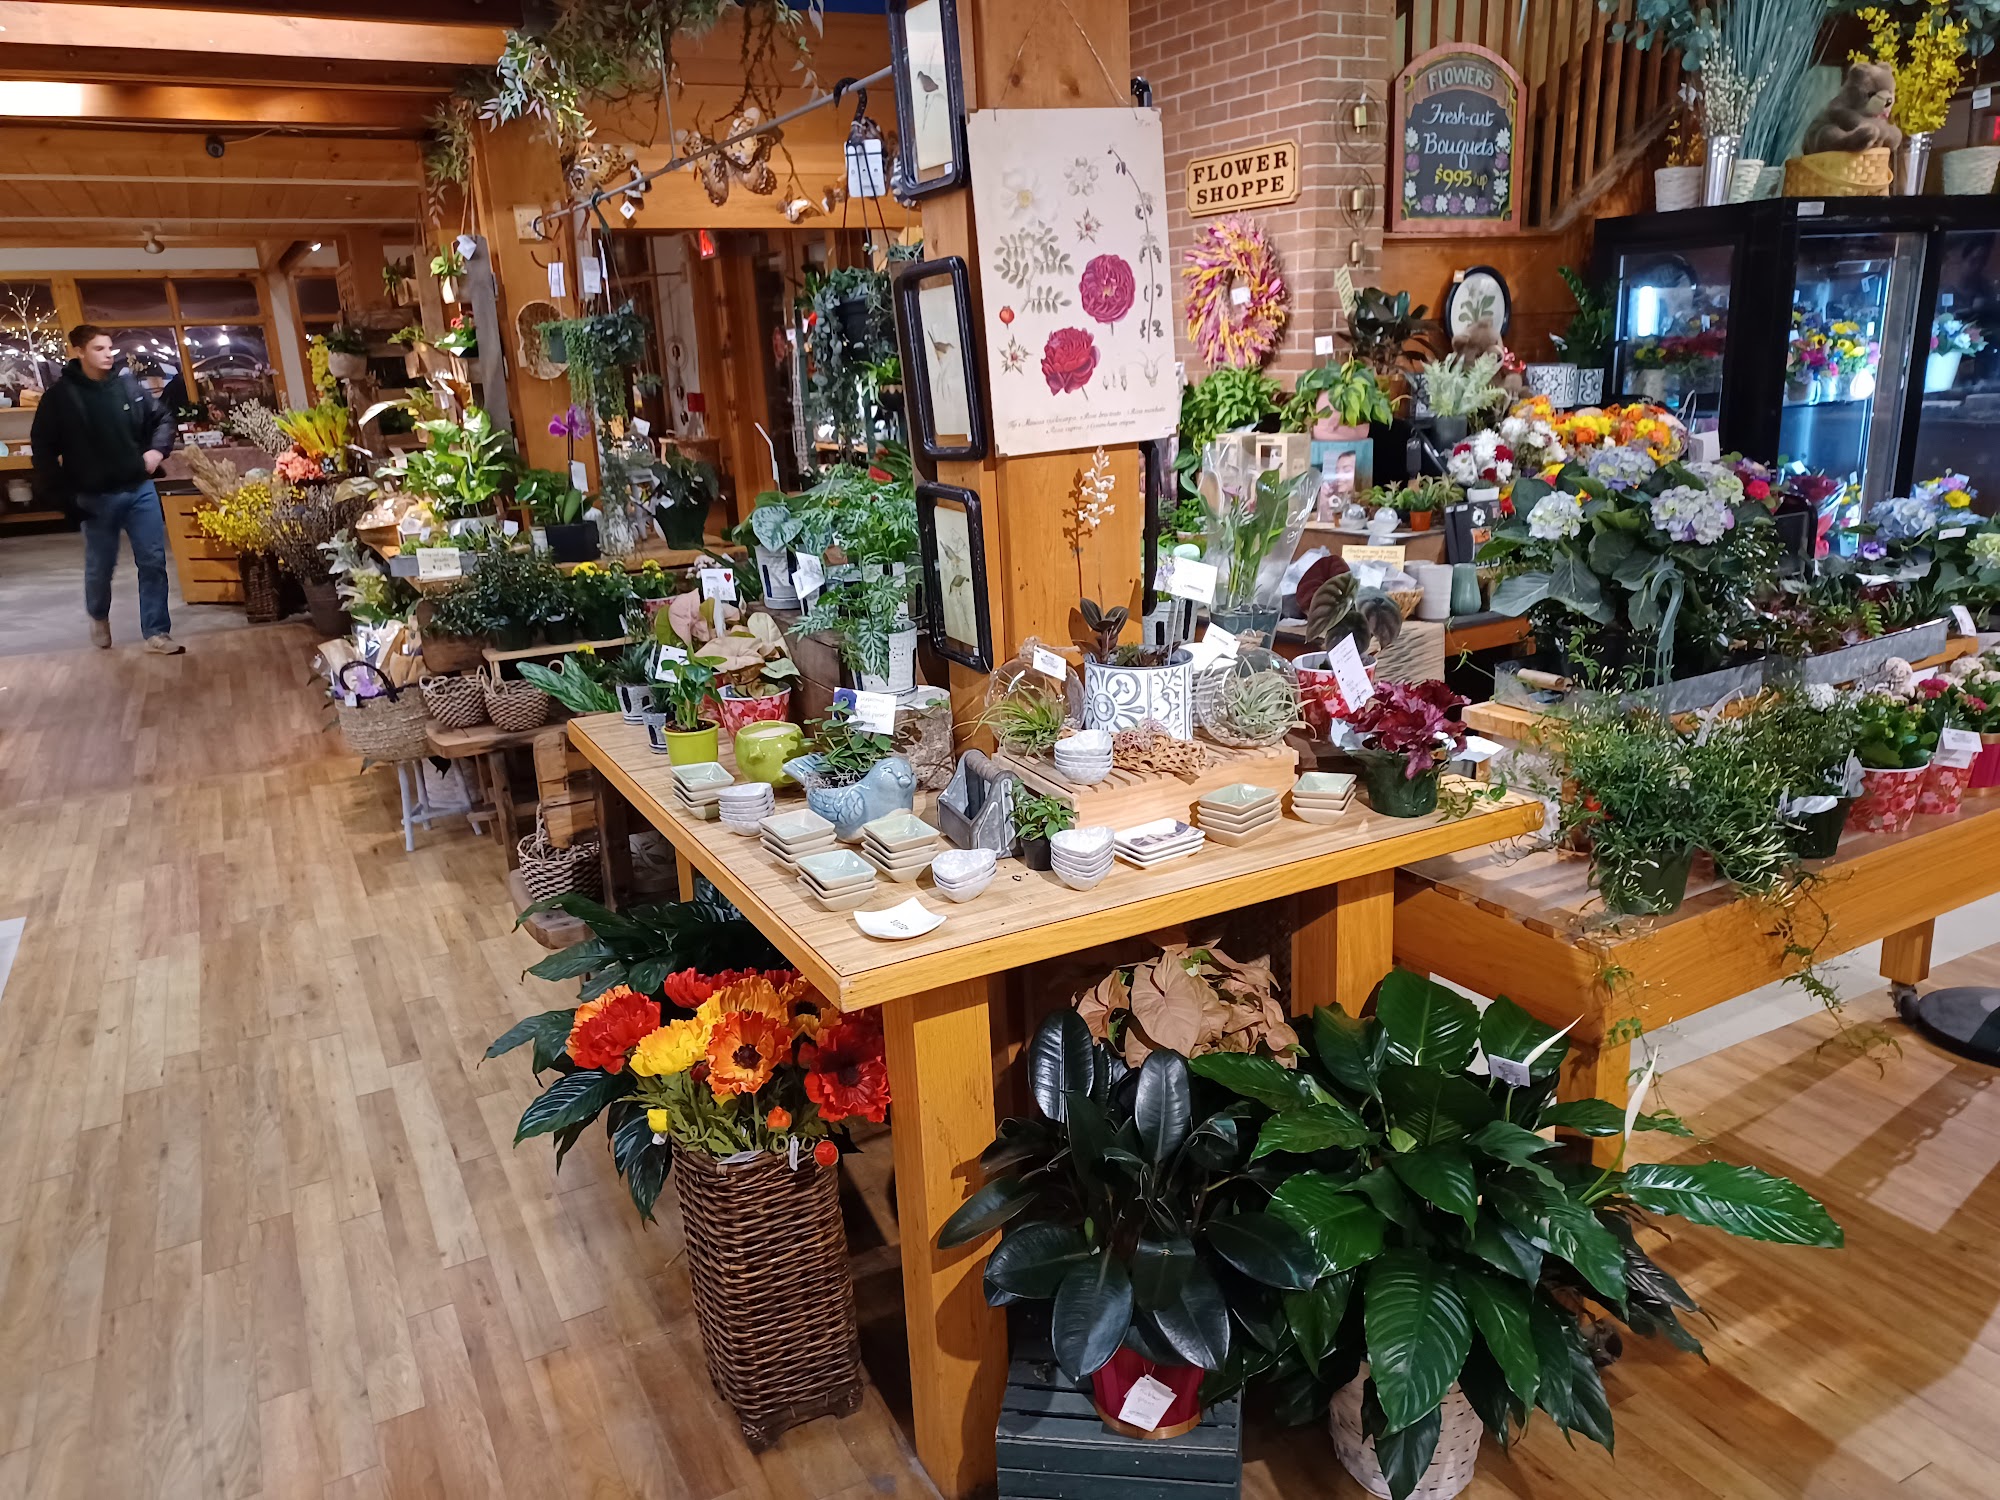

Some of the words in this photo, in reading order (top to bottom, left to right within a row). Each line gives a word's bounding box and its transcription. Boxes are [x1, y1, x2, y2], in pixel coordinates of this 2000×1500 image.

[1429, 66, 1493, 91] FLOWERS
[1422, 102, 1495, 127] Fresh-cut
[1423, 132, 1494, 170] Bouquets
[1193, 151, 1289, 184] FLOWER
[1197, 175, 1284, 205] SHOPPE
